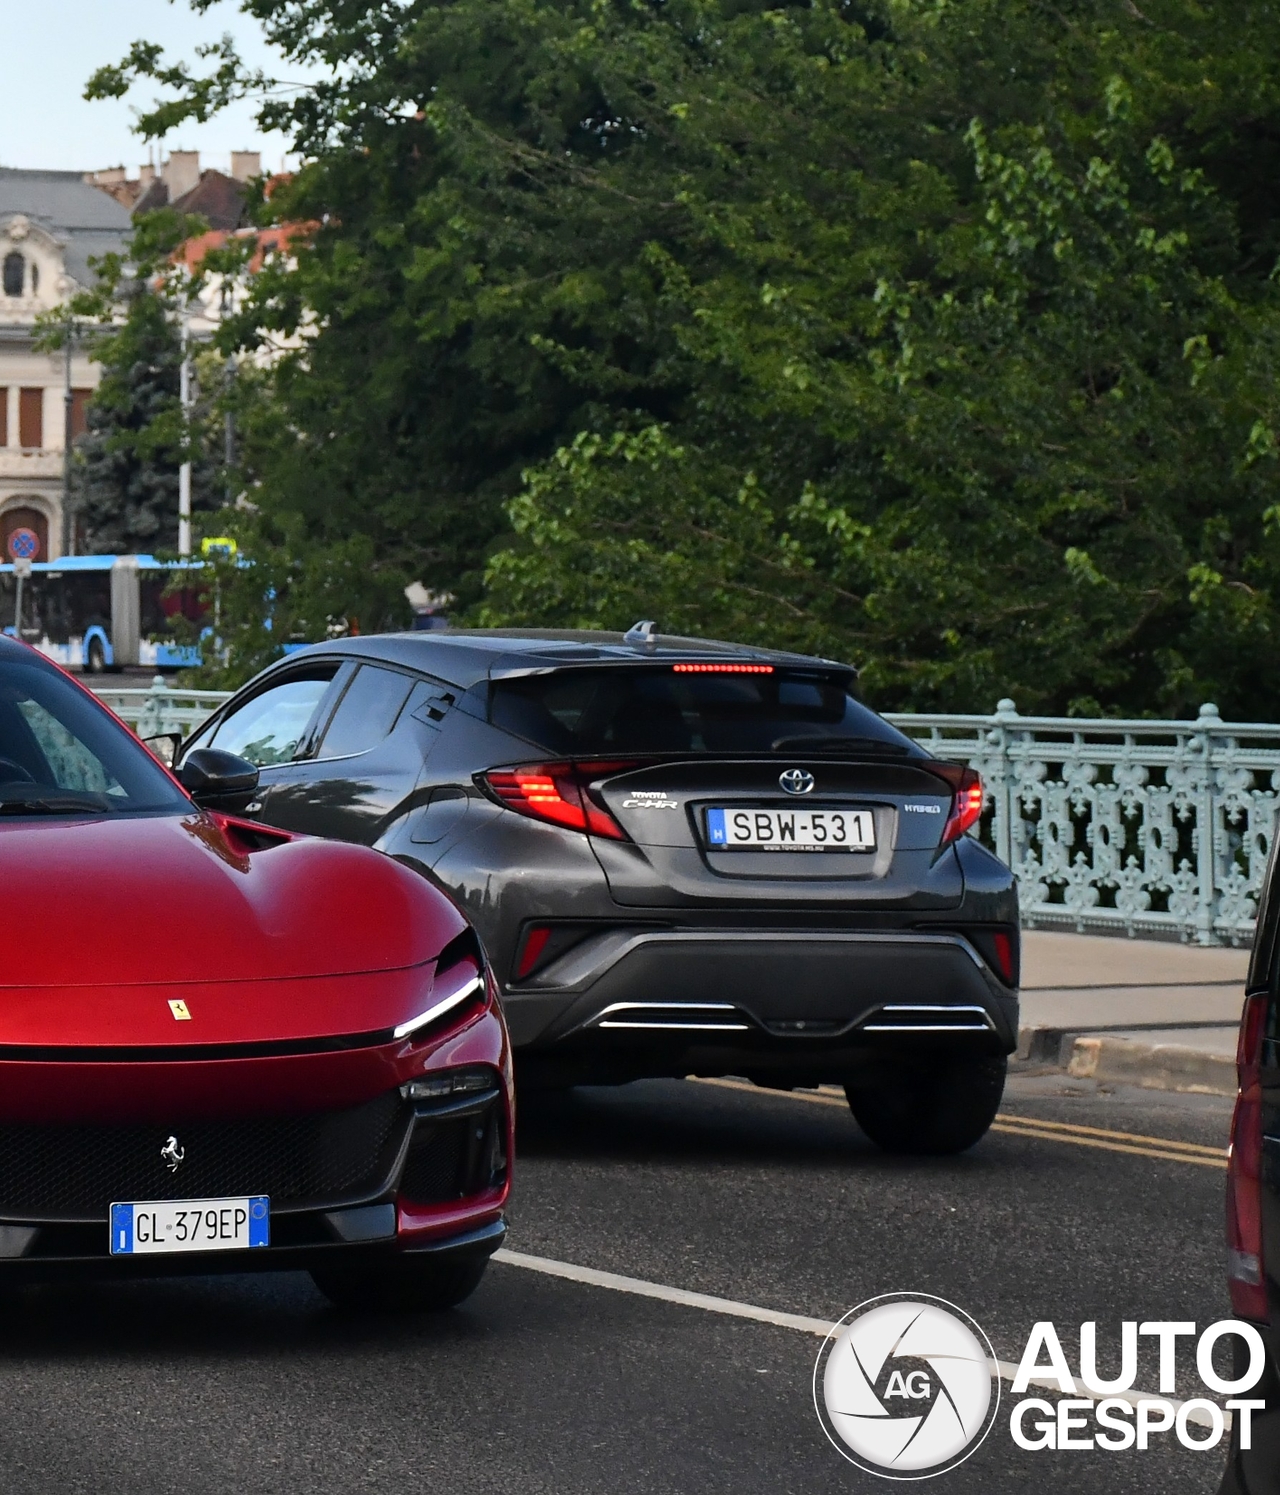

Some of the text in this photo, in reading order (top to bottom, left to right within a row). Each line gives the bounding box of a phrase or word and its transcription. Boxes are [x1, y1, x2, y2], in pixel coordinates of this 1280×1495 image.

[622, 800, 678, 809] C-HR
[631, 791, 667, 799] TOYOTA
[733, 813, 863, 842] SBW-531
[137, 1208, 247, 1243] GL 379EP
